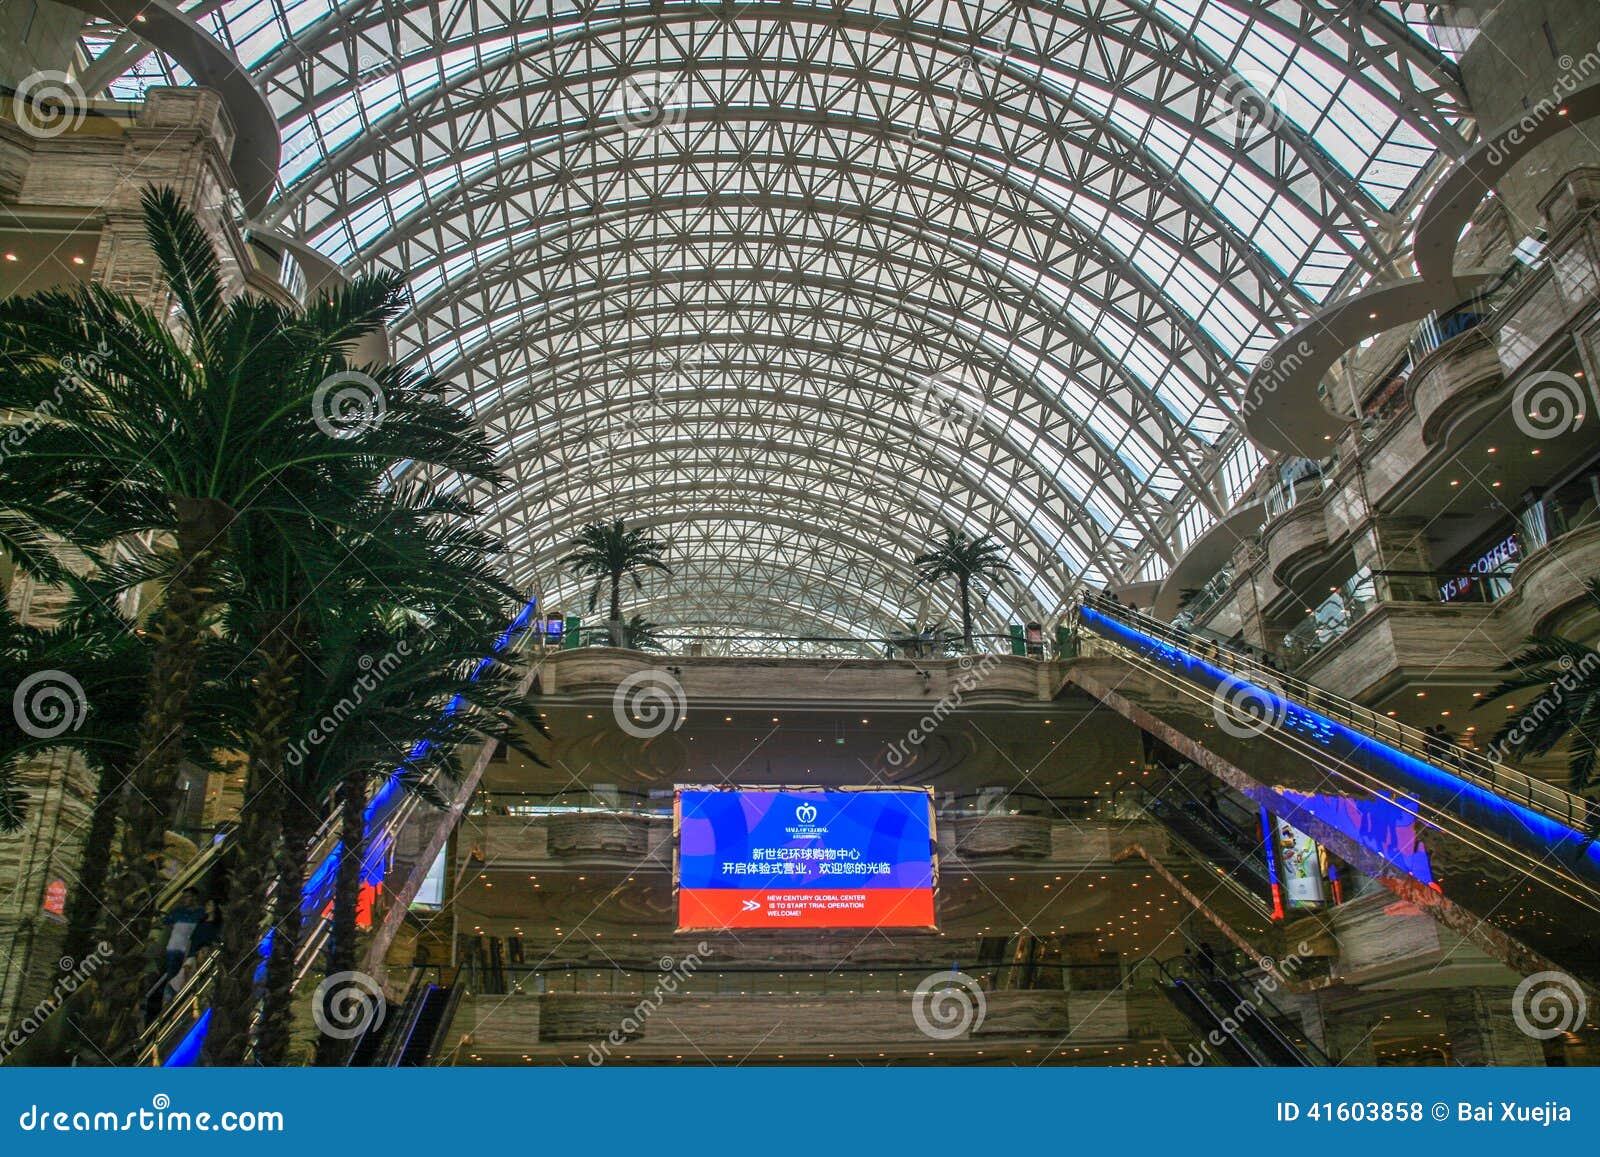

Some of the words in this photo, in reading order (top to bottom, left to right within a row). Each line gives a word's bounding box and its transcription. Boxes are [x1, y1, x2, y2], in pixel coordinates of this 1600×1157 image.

[1440, 580, 1457, 603] YS
[1469, 535, 1518, 580] COFFEE
[752, 848, 860, 861] 新世纪环球购物中心
